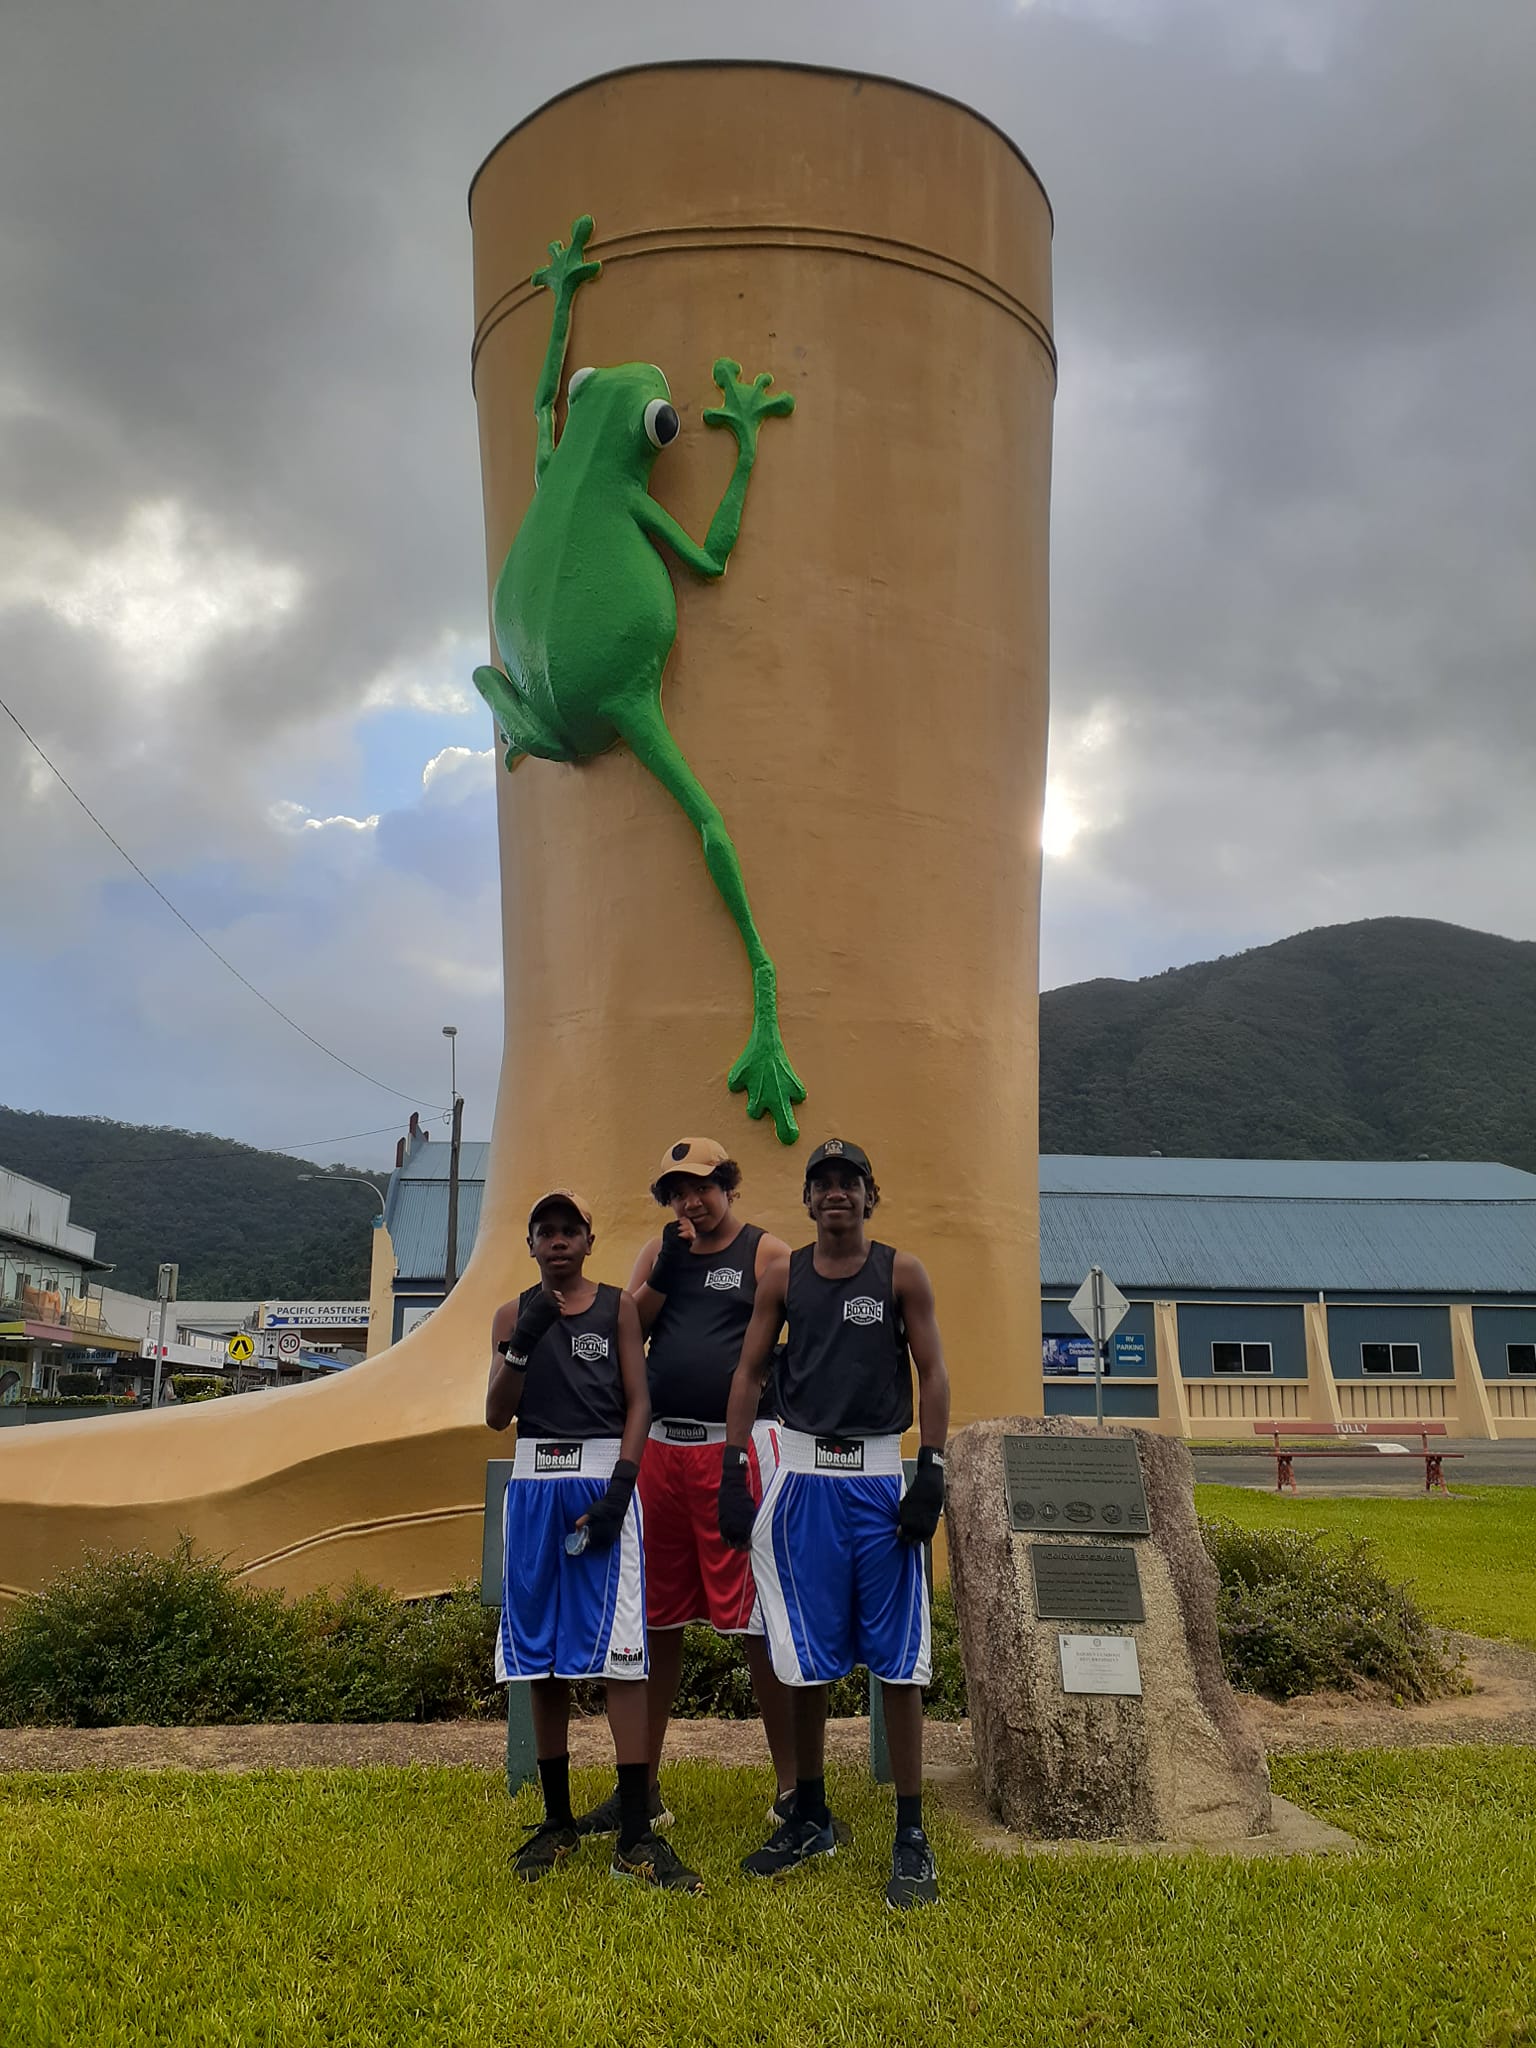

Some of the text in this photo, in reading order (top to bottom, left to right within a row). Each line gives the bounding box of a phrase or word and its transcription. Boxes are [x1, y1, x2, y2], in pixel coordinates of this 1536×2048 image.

[707, 1272, 740, 1286] BOXING
[277, 1306, 315, 1315] PACIFIC
[846, 1302, 882, 1319] BOXING
[298, 1316, 361, 1324] HYDRAULICS
[283, 1339, 297, 1348] 30
[573, 1339, 607, 1355] BOXING
[1116, 1343, 1144, 1351] PARKING
[1333, 1423, 1368, 1433] TULLY
[536, 1447, 580, 1466] MORGAN
[816, 1445, 862, 1464] MORGAN
[610, 1646, 643, 1662] MORGAN
